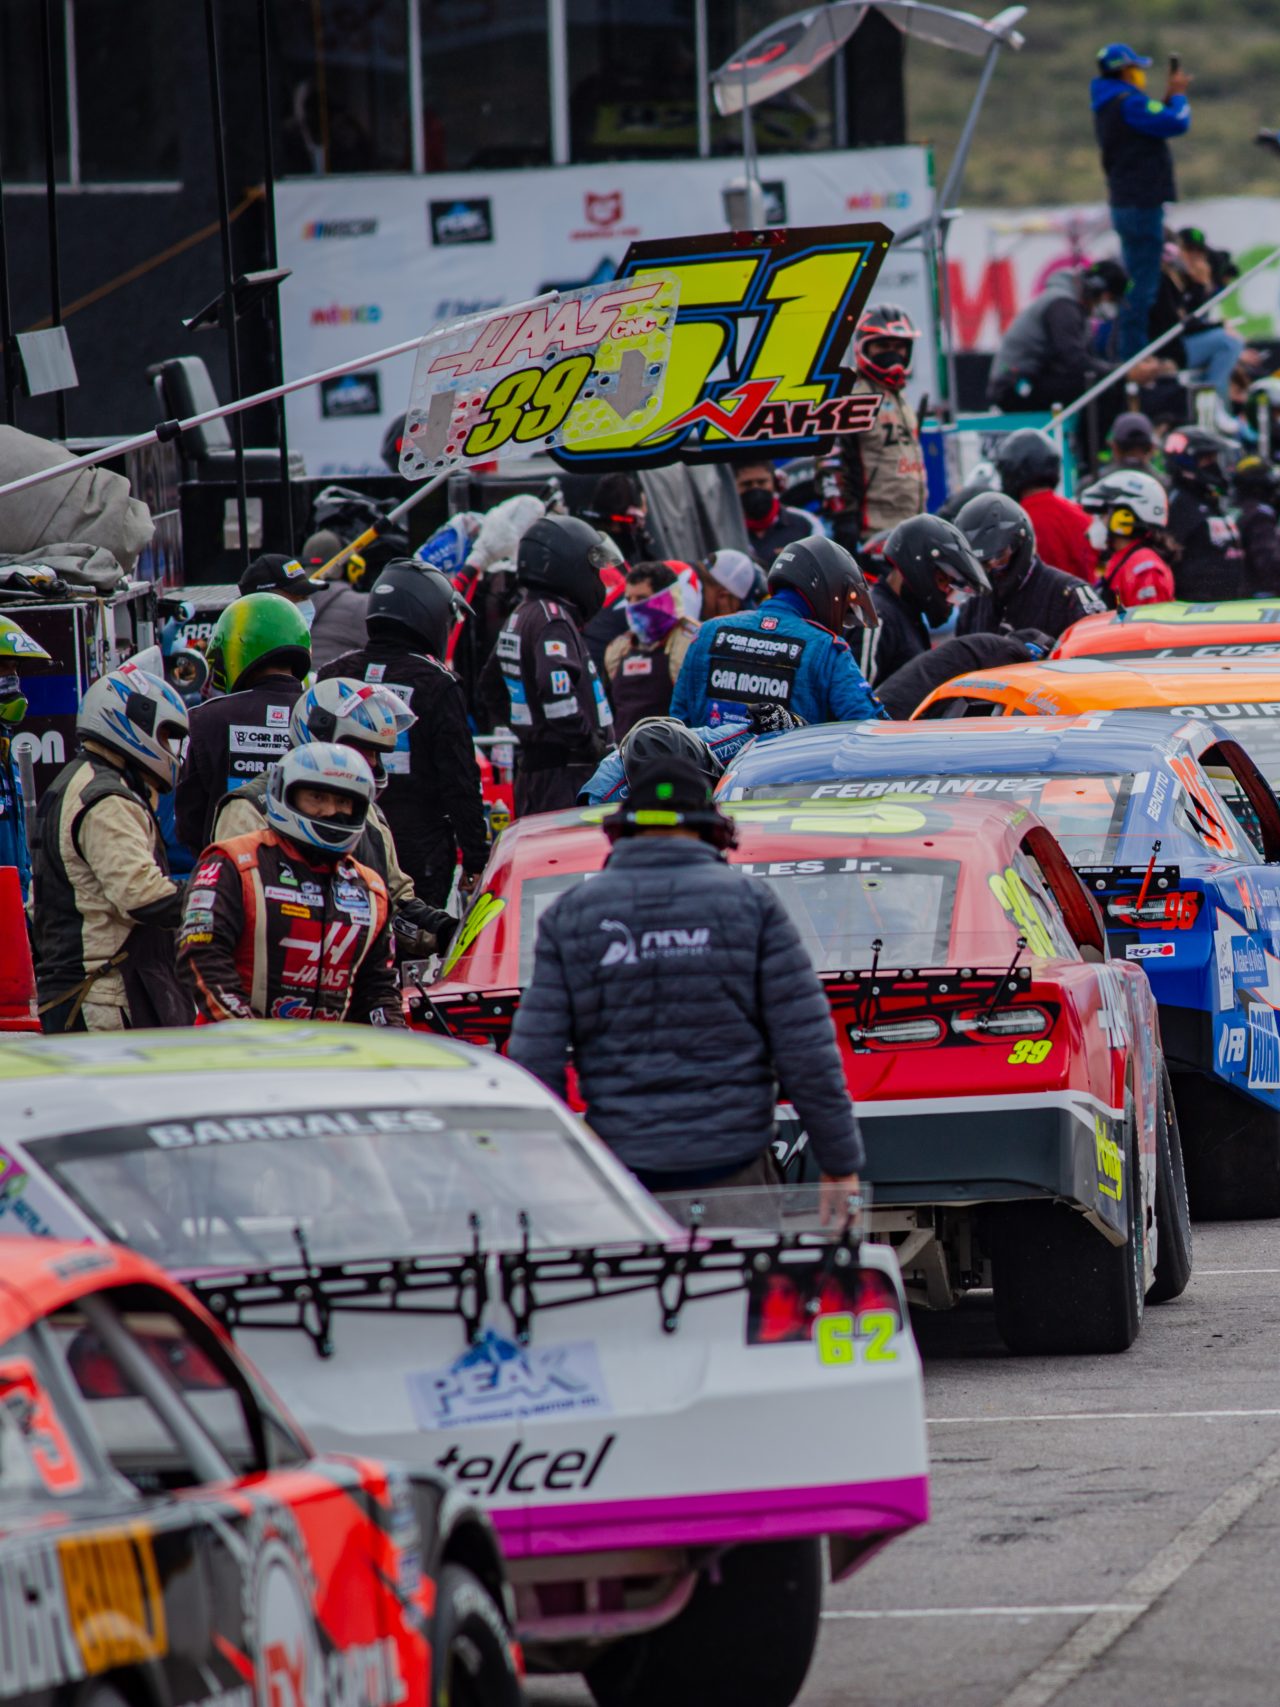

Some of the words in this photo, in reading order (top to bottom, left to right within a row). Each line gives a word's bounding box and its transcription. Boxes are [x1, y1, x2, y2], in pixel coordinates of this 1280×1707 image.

[427, 281, 665, 376] HAAS
[610, 315, 658, 341] CNC
[460, 353, 597, 458] 39
[726, 634, 748, 647] CAR
[747, 637, 789, 653] MOTION
[711, 669, 738, 692] CAR
[736, 672, 790, 699] MOTION
[233, 760, 265, 773] CAR
[810, 777, 1052, 801] FERNANDEZ
[1160, 891, 1200, 931] 96
[1007, 1039, 1053, 1064] 39
[147, 1109, 447, 1149] BARRALES
[815, 1310, 898, 1365] 62
[435, 1434, 619, 1497] telcel
